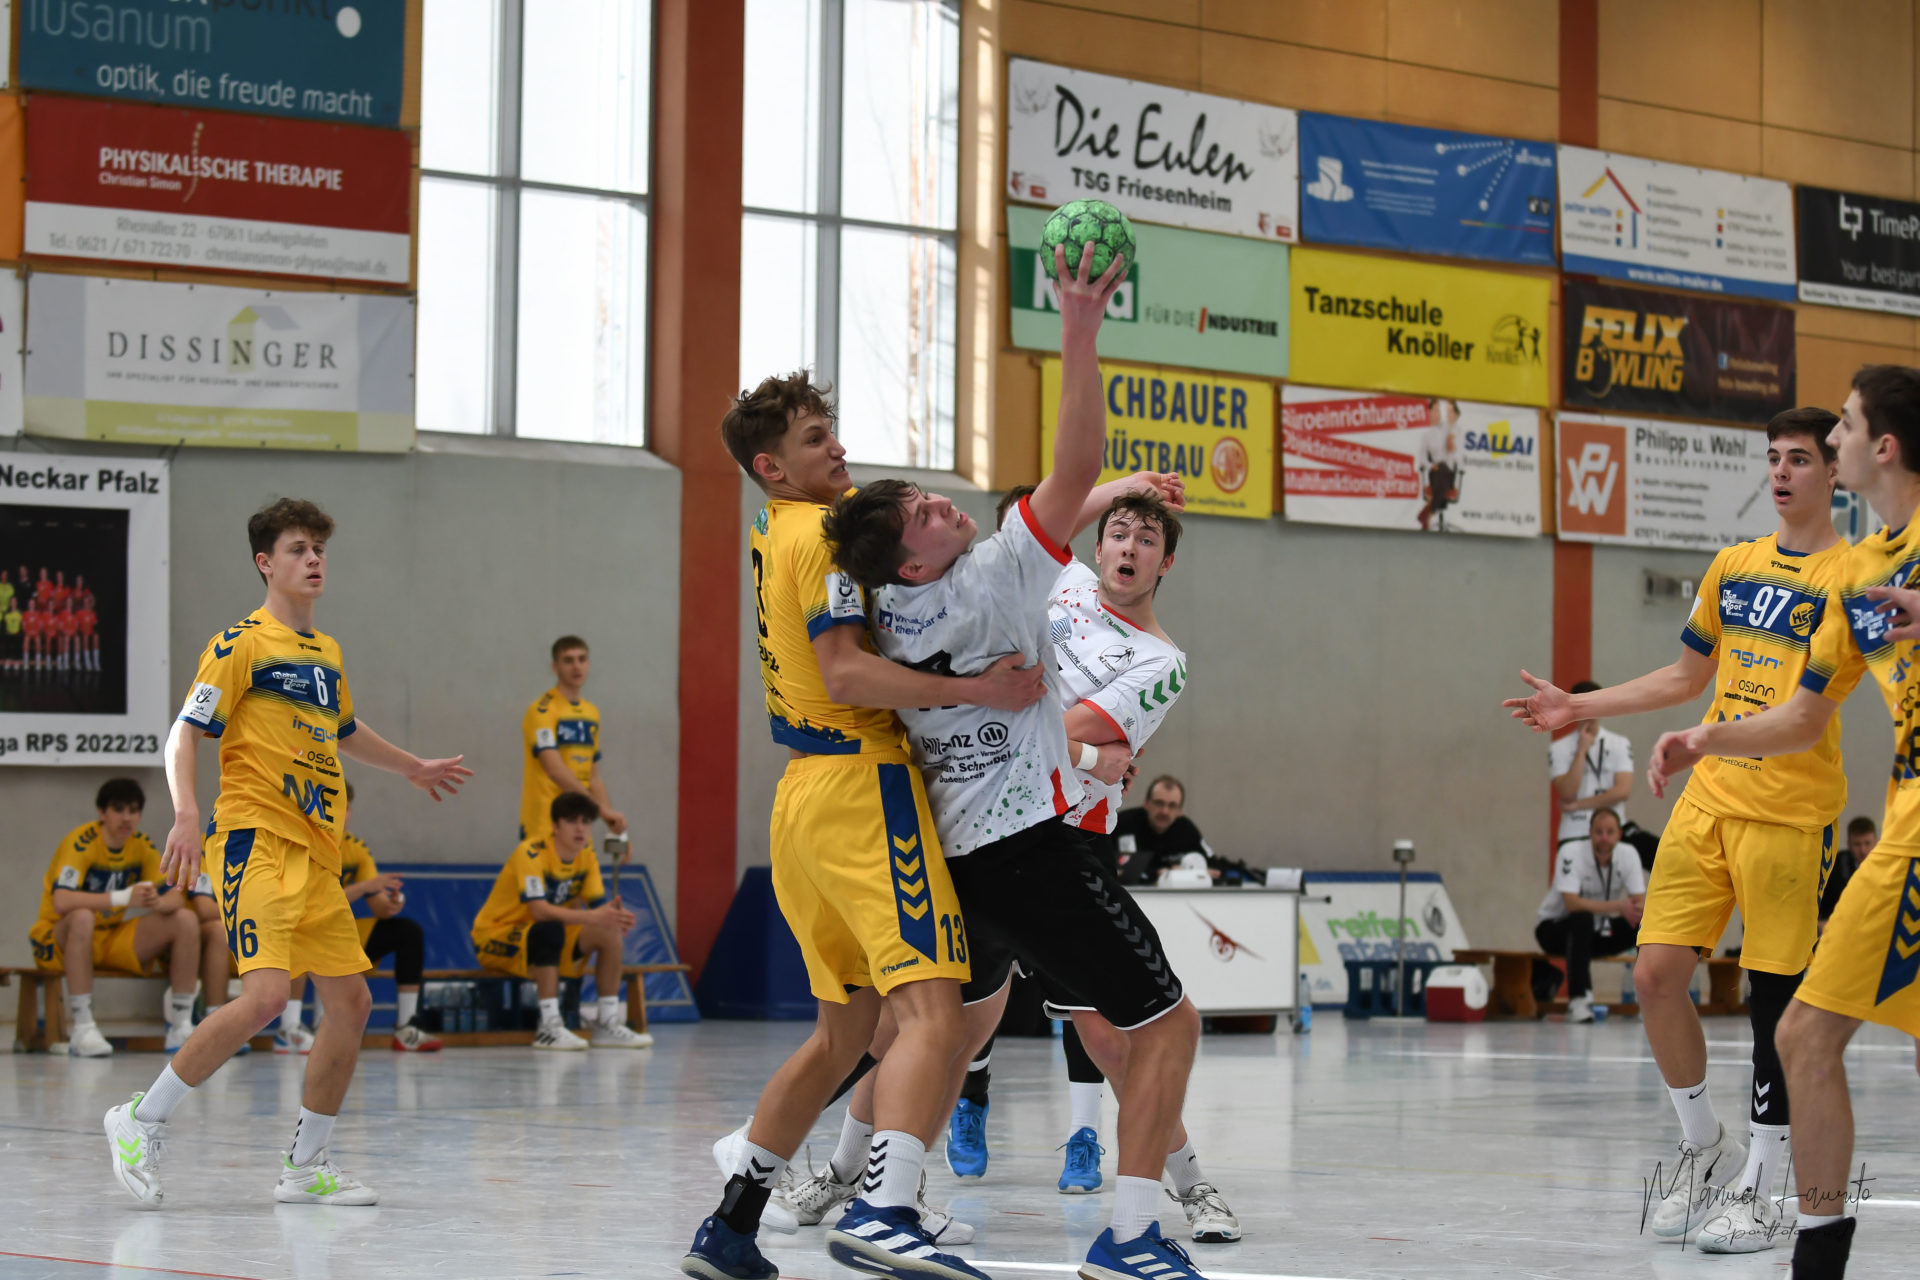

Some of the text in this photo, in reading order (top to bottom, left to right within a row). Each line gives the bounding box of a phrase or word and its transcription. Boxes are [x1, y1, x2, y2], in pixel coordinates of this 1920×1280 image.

[97, 62, 373, 118] optik, die freude macht
[1055, 84, 1254, 184] Die Eulen
[99, 171, 182, 191] Christian Simon
[100, 146, 342, 191] PHYSIKALISCHE THERAPIE
[1072, 167, 1233, 213] TSG Friesenheim
[181, 222, 197, 238] 22
[1869, 208, 1920, 240] TimeP
[76, 234, 108, 253] 0621
[1145, 305, 1170, 325] FÜR
[1173, 308, 1196, 328] DIE
[1304, 285, 1443, 326] Tanzschule
[1387, 327, 1474, 361] Knöller
[1580, 304, 1687, 358] FELIX
[107, 330, 338, 369] DISSINGER
[1100, 374, 1248, 430] CHBAUER
[1464, 431, 1534, 456] SALLAI
[1635, 426, 1689, 456] Philipp
[1710, 435, 1747, 458] Wahl
[0, 464, 160, 494] Neckar Pfalz
[1749, 585, 1793, 629] 97
[313, 666, 329, 706] 6
[1738, 679, 1776, 700] osann
[26, 733, 68, 753] RPS
[75, 733, 159, 754] 2022/23
[921, 734, 974, 756] Allianz
[239, 918, 259, 959] 6
[940, 913, 967, 964] 13
[887, 956, 920, 972] hummel
